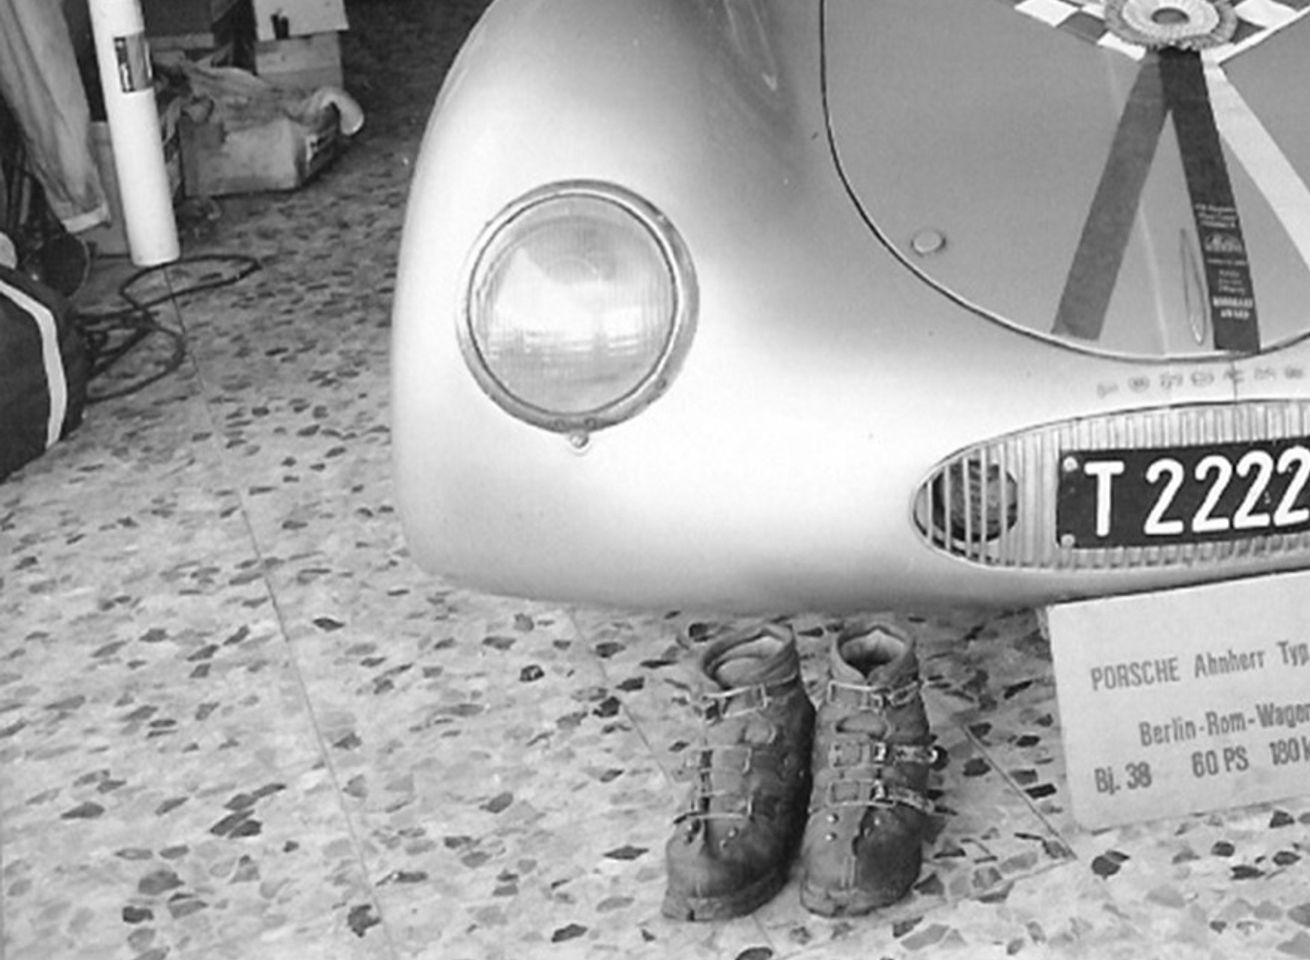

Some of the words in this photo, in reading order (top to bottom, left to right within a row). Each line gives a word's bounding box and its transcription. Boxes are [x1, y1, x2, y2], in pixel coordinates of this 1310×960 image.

[1084, 460, 1125, 536] T
[1091, 657, 1181, 691] PORSCHE
[1195, 649, 1265, 679] Ahnherr
[1277, 640, 1310, 667] Typ
[1094, 767, 1122, 795] Bj.
[1125, 761, 1152, 790] 38
[1191, 749, 1219, 779] 60
[1223, 745, 1250, 773] PS
[1269, 737, 1301, 766] 180
